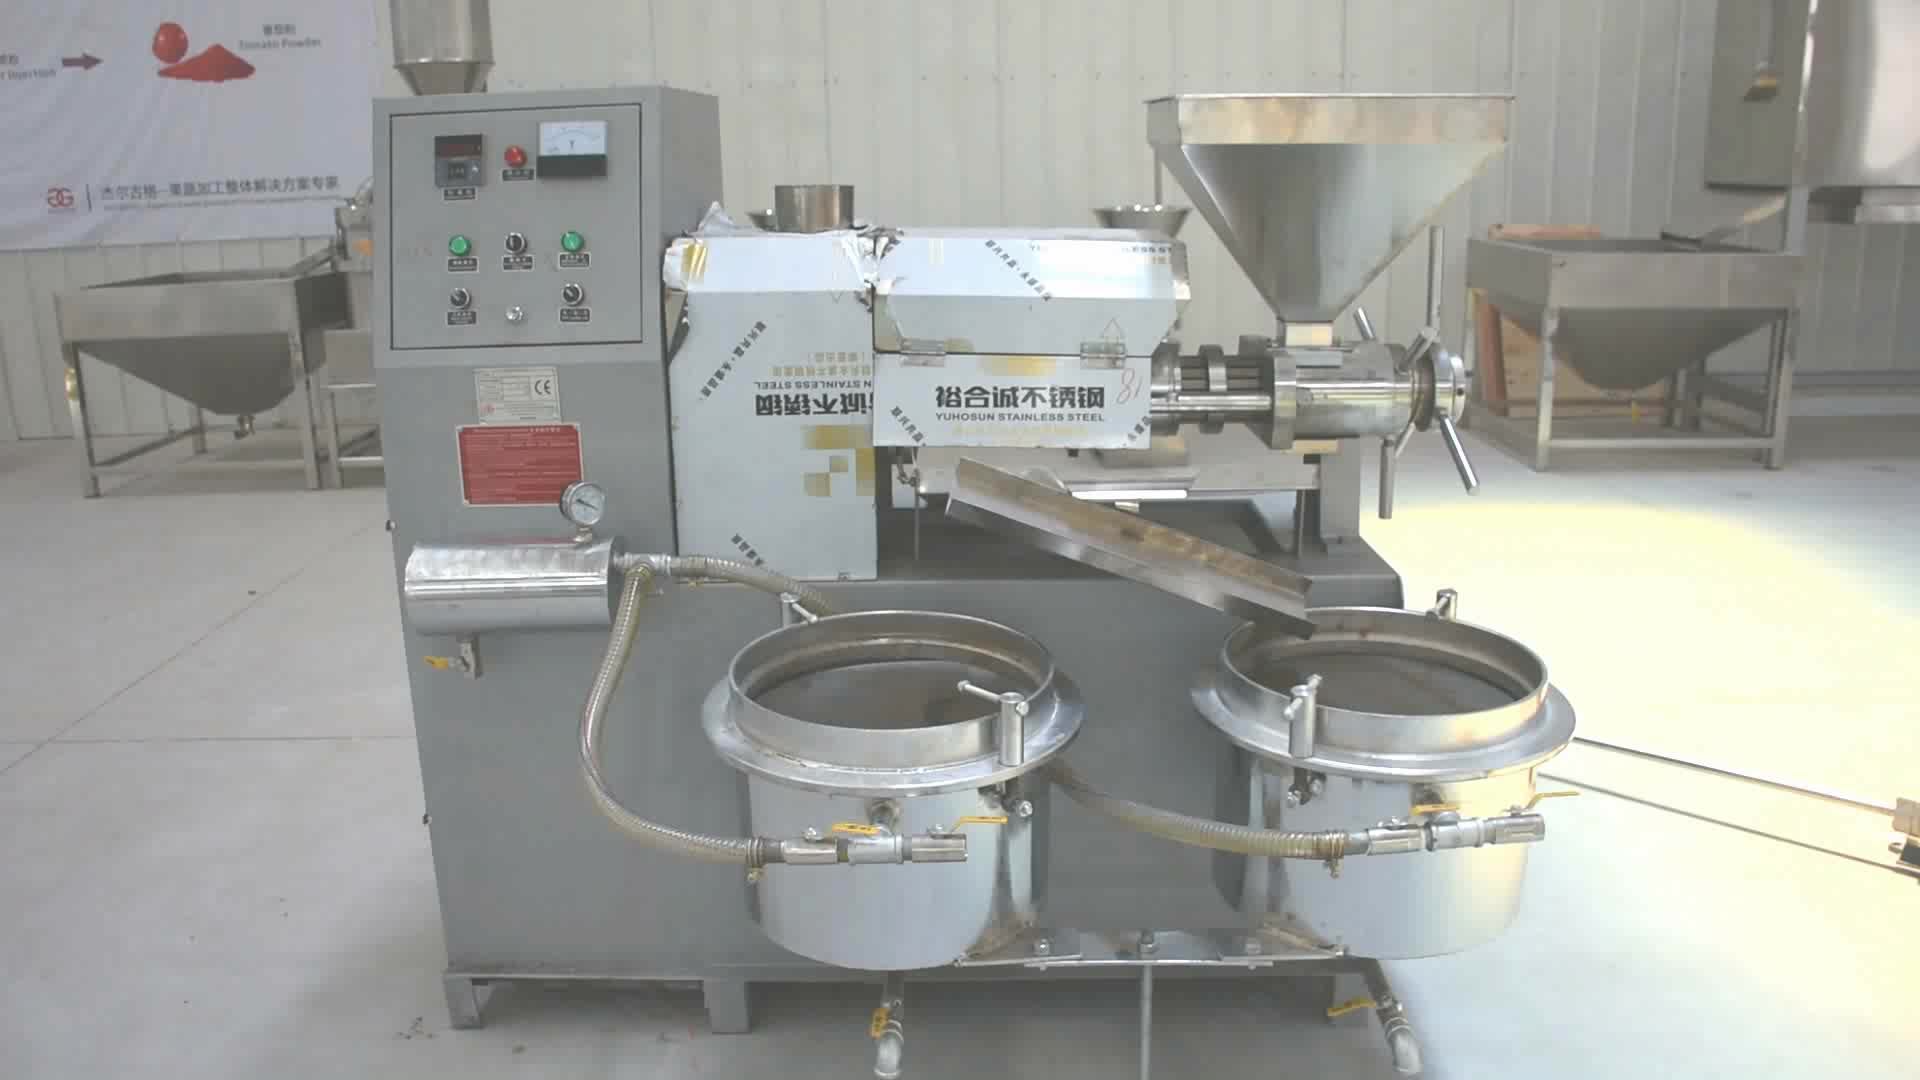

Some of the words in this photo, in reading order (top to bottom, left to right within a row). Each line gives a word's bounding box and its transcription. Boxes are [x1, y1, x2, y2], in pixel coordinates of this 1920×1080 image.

[534, 379, 551, 395] CE
[935, 385, 1105, 409] 裕合诚不锈钢
[755, 392, 873, 416] 诚不锈钢
[935, 412, 995, 422] YUHOSUN
[998, 412, 1065, 422] STAINLESS
[1067, 412, 1105, 422] STEEL
